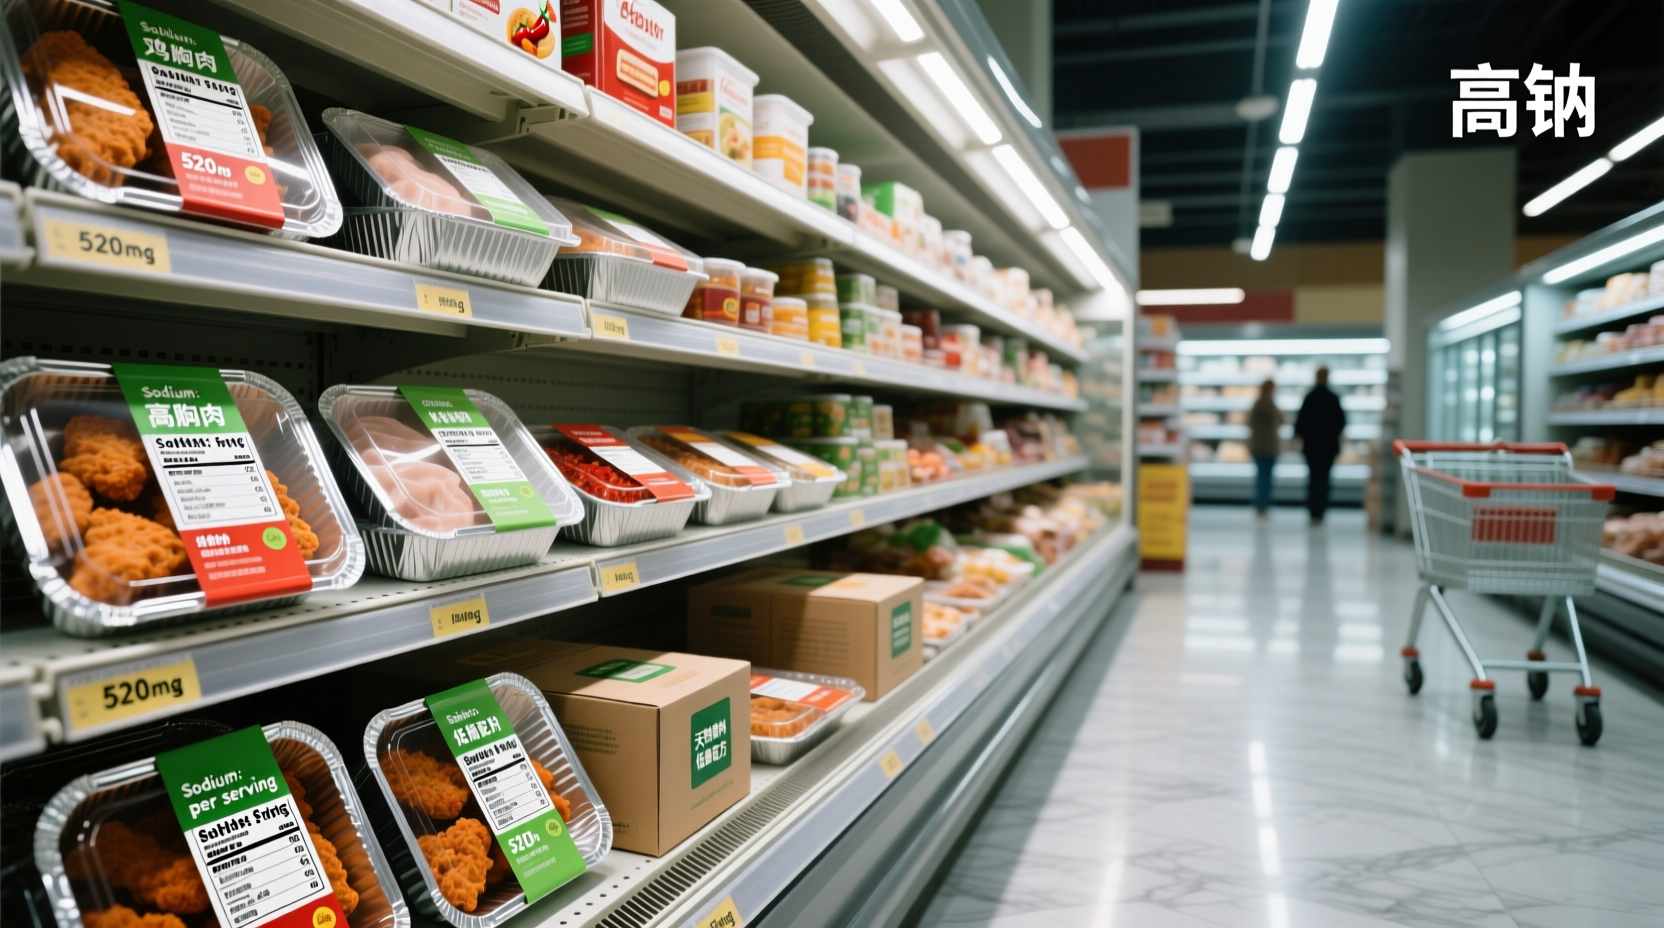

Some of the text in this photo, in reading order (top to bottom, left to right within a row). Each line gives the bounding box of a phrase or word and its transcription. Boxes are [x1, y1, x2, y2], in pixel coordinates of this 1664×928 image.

[78, 231, 155, 265] 520mg
[141, 384, 200, 399] Sodium:
[103, 677, 184, 709] 520mg
[181, 769, 243, 798] Sodium:
[189, 775, 278, 820] per serving
